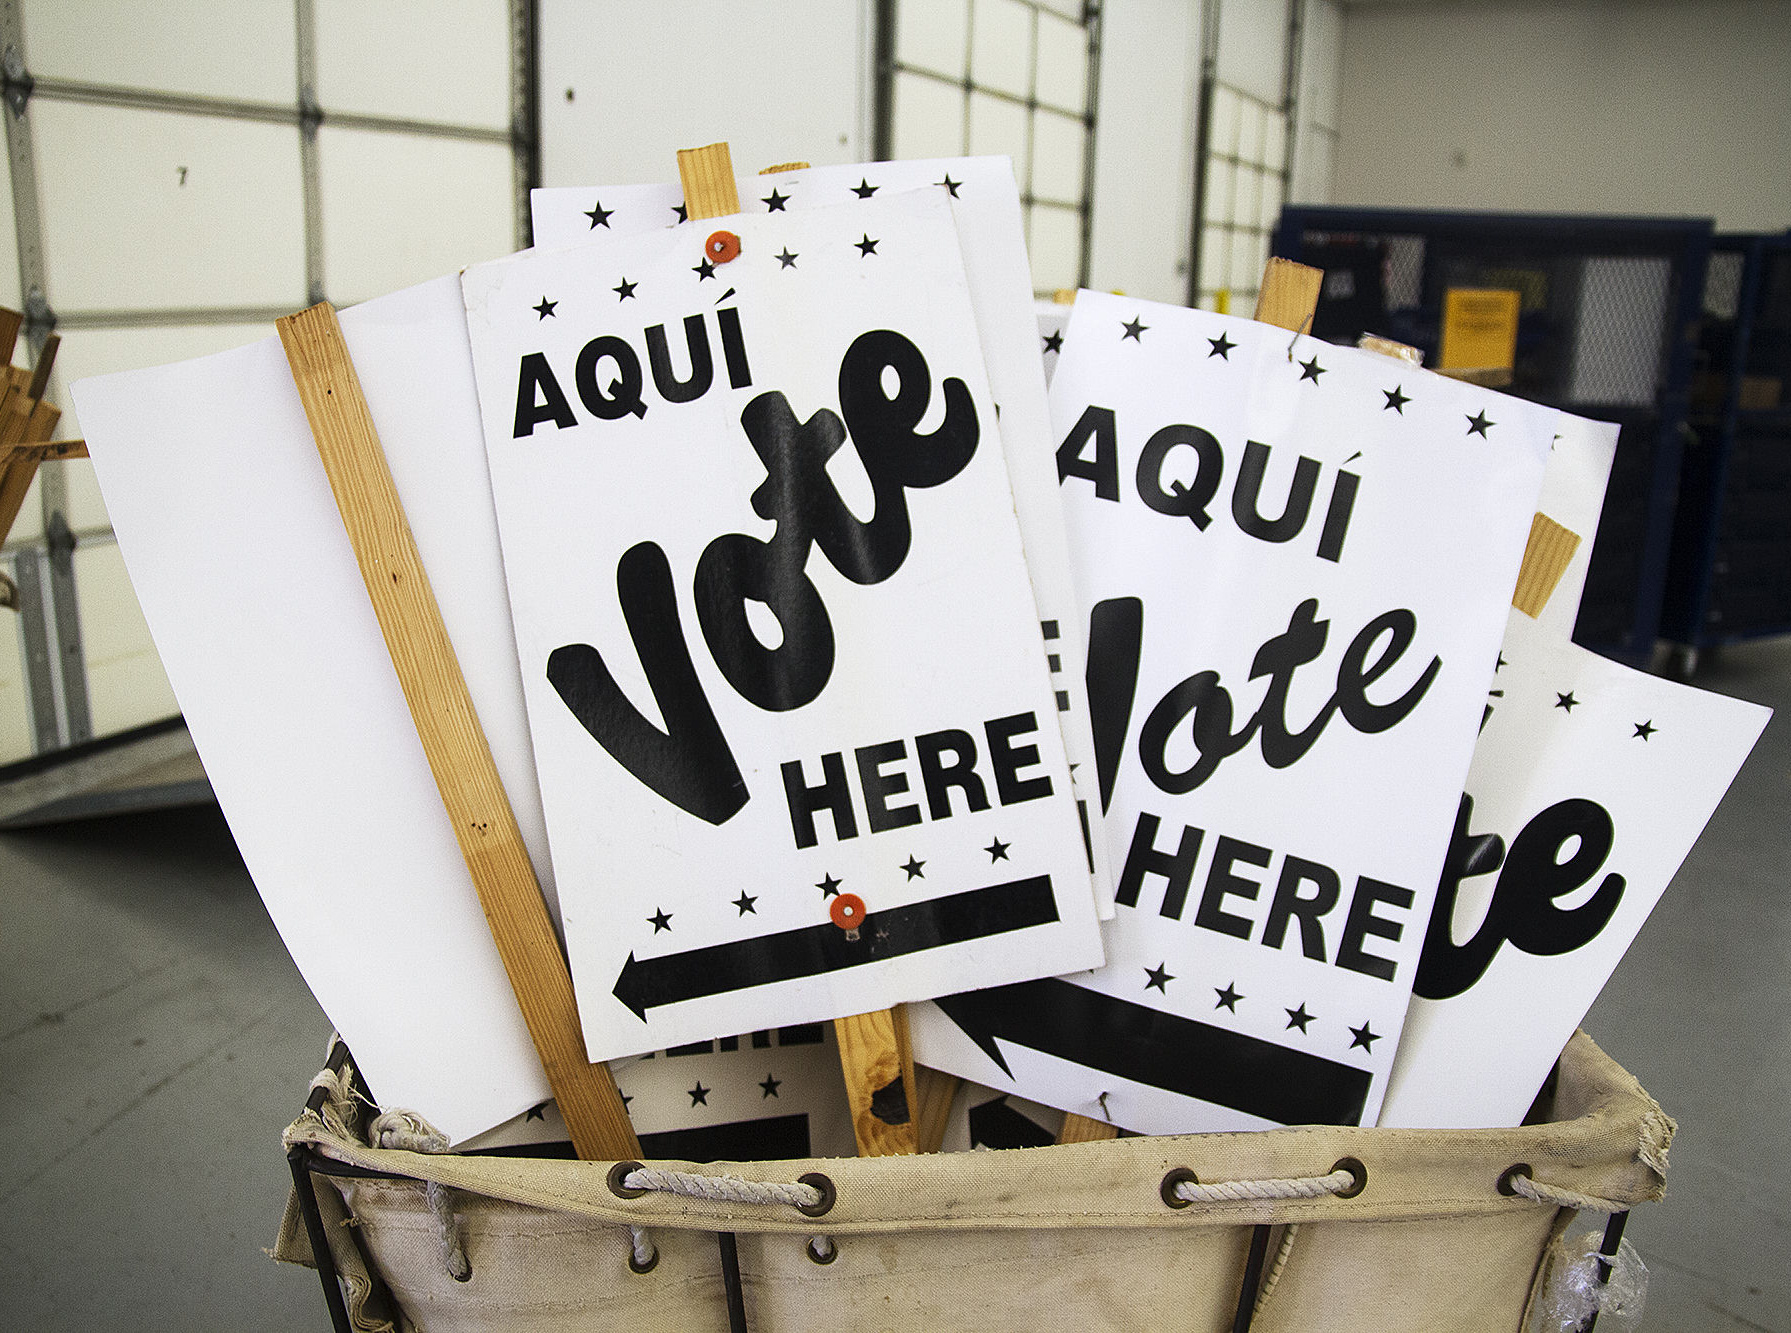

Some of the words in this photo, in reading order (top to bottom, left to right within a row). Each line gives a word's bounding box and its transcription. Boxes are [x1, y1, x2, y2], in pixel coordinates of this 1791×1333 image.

[512, 287, 753, 439] AQUÍ
[1056, 405, 1363, 564] AQUÍ
[546, 329, 981, 827] Vote
[779, 711, 1056, 850] HERE
[1114, 811, 1417, 983] HERE
